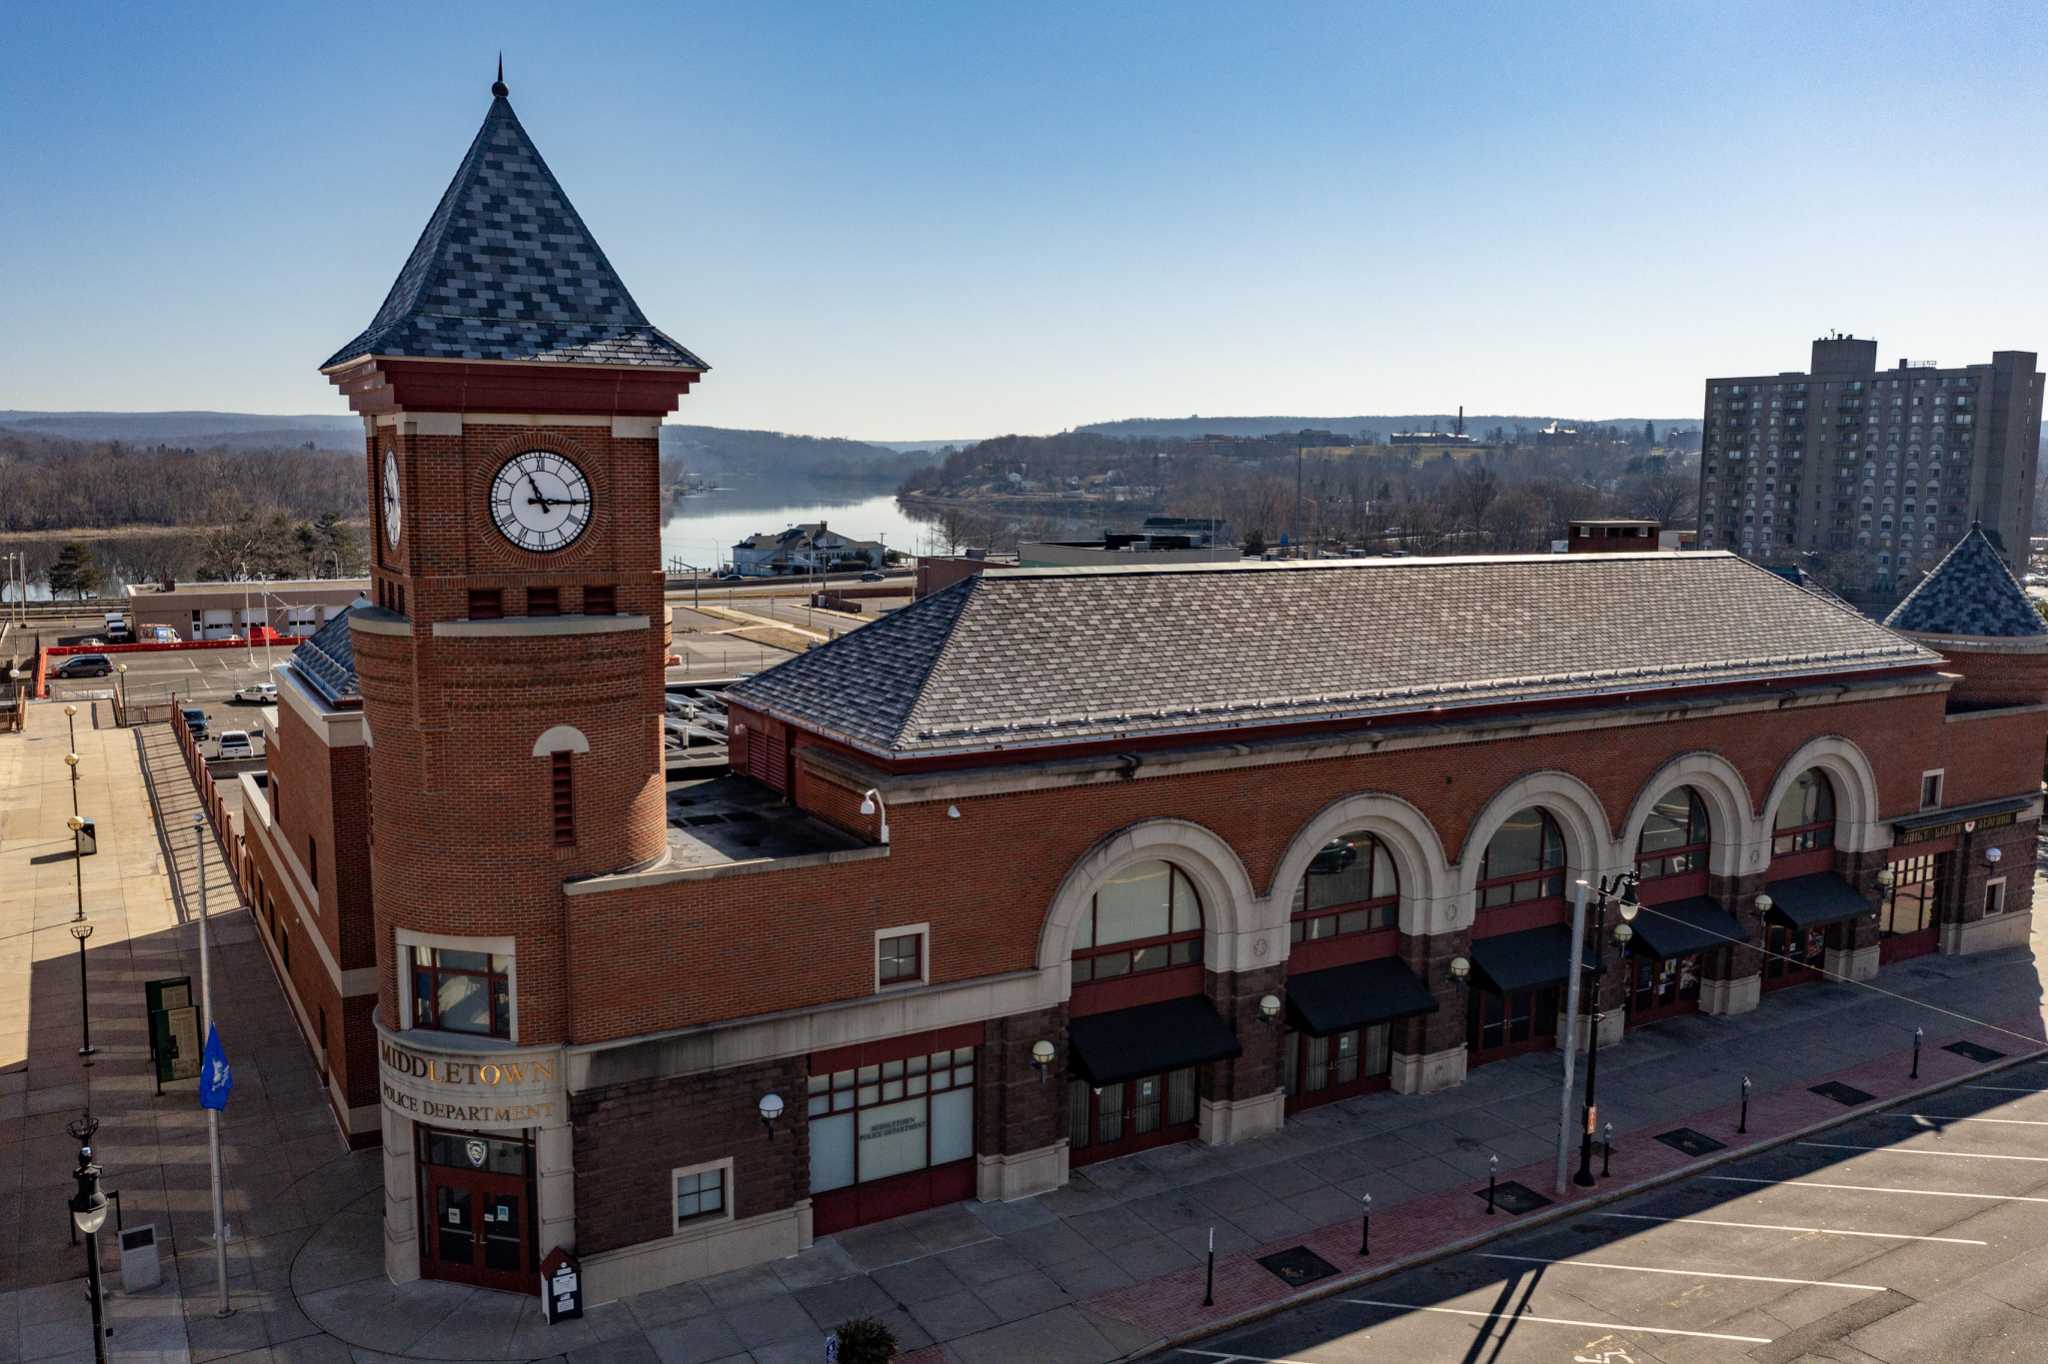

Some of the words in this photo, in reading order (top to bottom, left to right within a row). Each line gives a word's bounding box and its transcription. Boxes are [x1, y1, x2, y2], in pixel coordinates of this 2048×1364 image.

[381, 1039, 556, 1087] MIDDLETOWN
[383, 1081, 418, 1112] POLICE
[423, 1100, 555, 1122] DEPARTMENT
